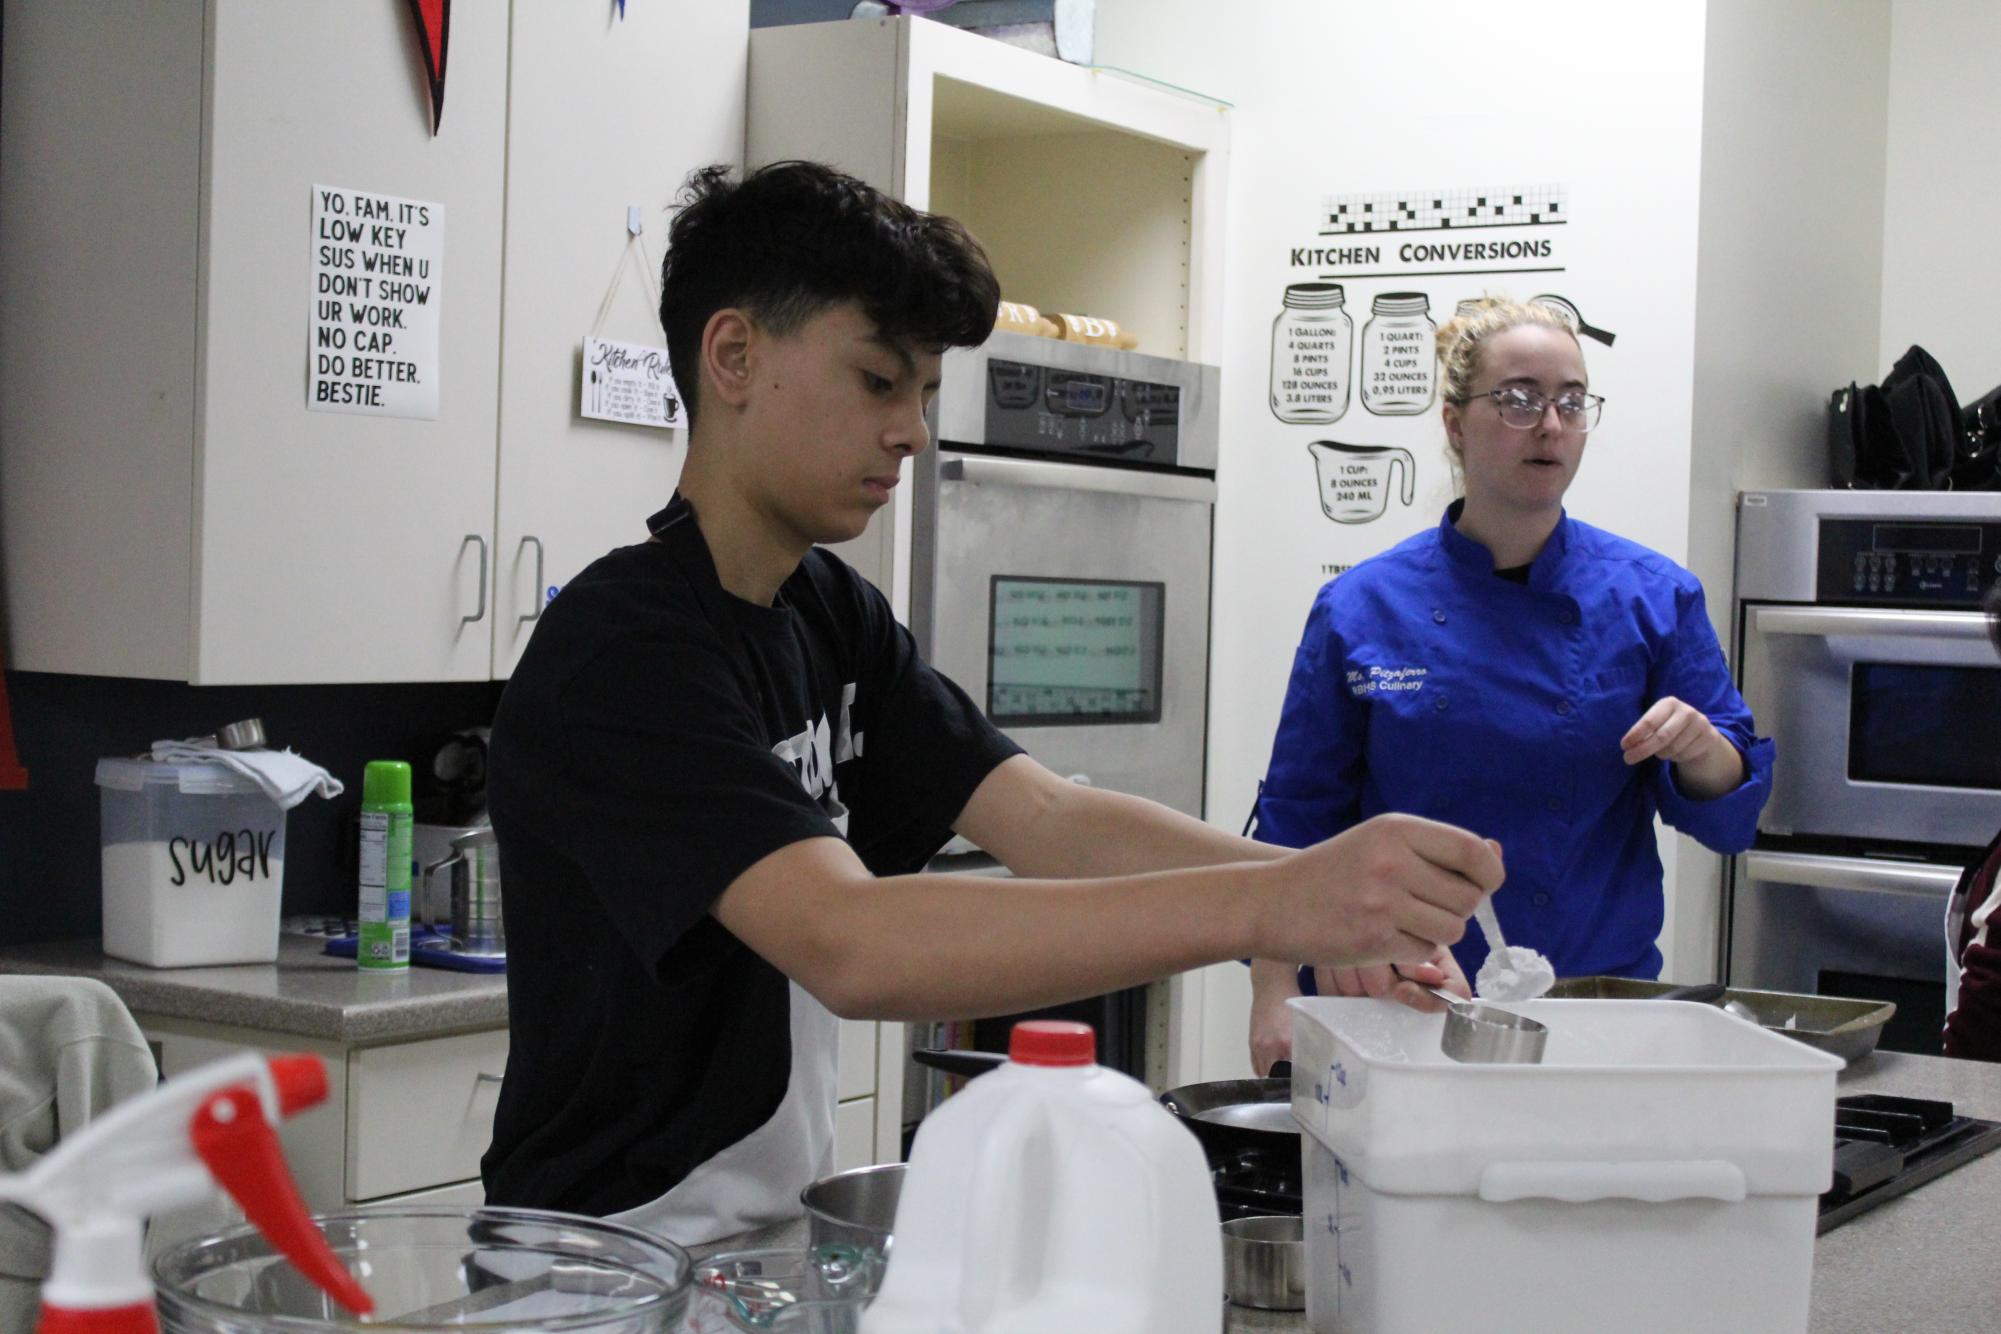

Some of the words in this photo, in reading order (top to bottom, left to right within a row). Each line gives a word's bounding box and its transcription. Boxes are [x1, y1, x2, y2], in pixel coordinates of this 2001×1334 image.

[321, 191, 350, 216] YO.
[355, 196, 394, 223] FAM.
[399, 203, 430, 226] IT'S
[320, 217, 363, 243] LOW
[371, 225, 406, 249] KEY
[1291, 246, 1380, 267] KITCHEN
[1399, 240, 1551, 262] CONVERSIONS
[319, 245, 355, 270] SUS
[361, 250, 413, 277] WHEN
[419, 259, 429, 279] U
[319, 272, 373, 298] DON'T
[379, 280, 430, 306] SHOW
[318, 300, 342, 323] UR
[349, 303, 407, 329] WORK.
[318, 326, 346, 350] NO
[353, 330, 397, 355] CAP.
[1288, 340, 1294, 350] 4
[1297, 341, 1335, 351] QUARTS
[1383, 345, 1389, 355] 2
[1392, 345, 1419, 354] PINTS
[591, 343, 639, 373] Kitchen
[1294, 354, 1299, 363] 8
[1302, 354, 1328, 363] PINTS
[1384, 359, 1390, 367] 4
[1393, 359, 1417, 368] CUPS
[318, 354, 345, 376] DO
[352, 356, 421, 384] BETTER.
[1293, 367, 1302, 376] 16
[1305, 367, 1328, 377] CUPS
[1373, 372, 1386, 381] 32
[1389, 372, 1427, 381] OUNCES
[1300, 380, 1338, 390] OUNCES
[1397, 385, 1427, 395] LITERS
[316, 380, 385, 407] BESTIE.
[1303, 394, 1332, 403] LITERS
[1331, 479, 1337, 488] 8
[1339, 478, 1378, 488] OUNCES
[1336, 492, 1355, 501] 240
[1358, 491, 1372, 501] ML
[1379, 680, 1423, 691] Culinary
[169, 829, 276, 887] sugar
